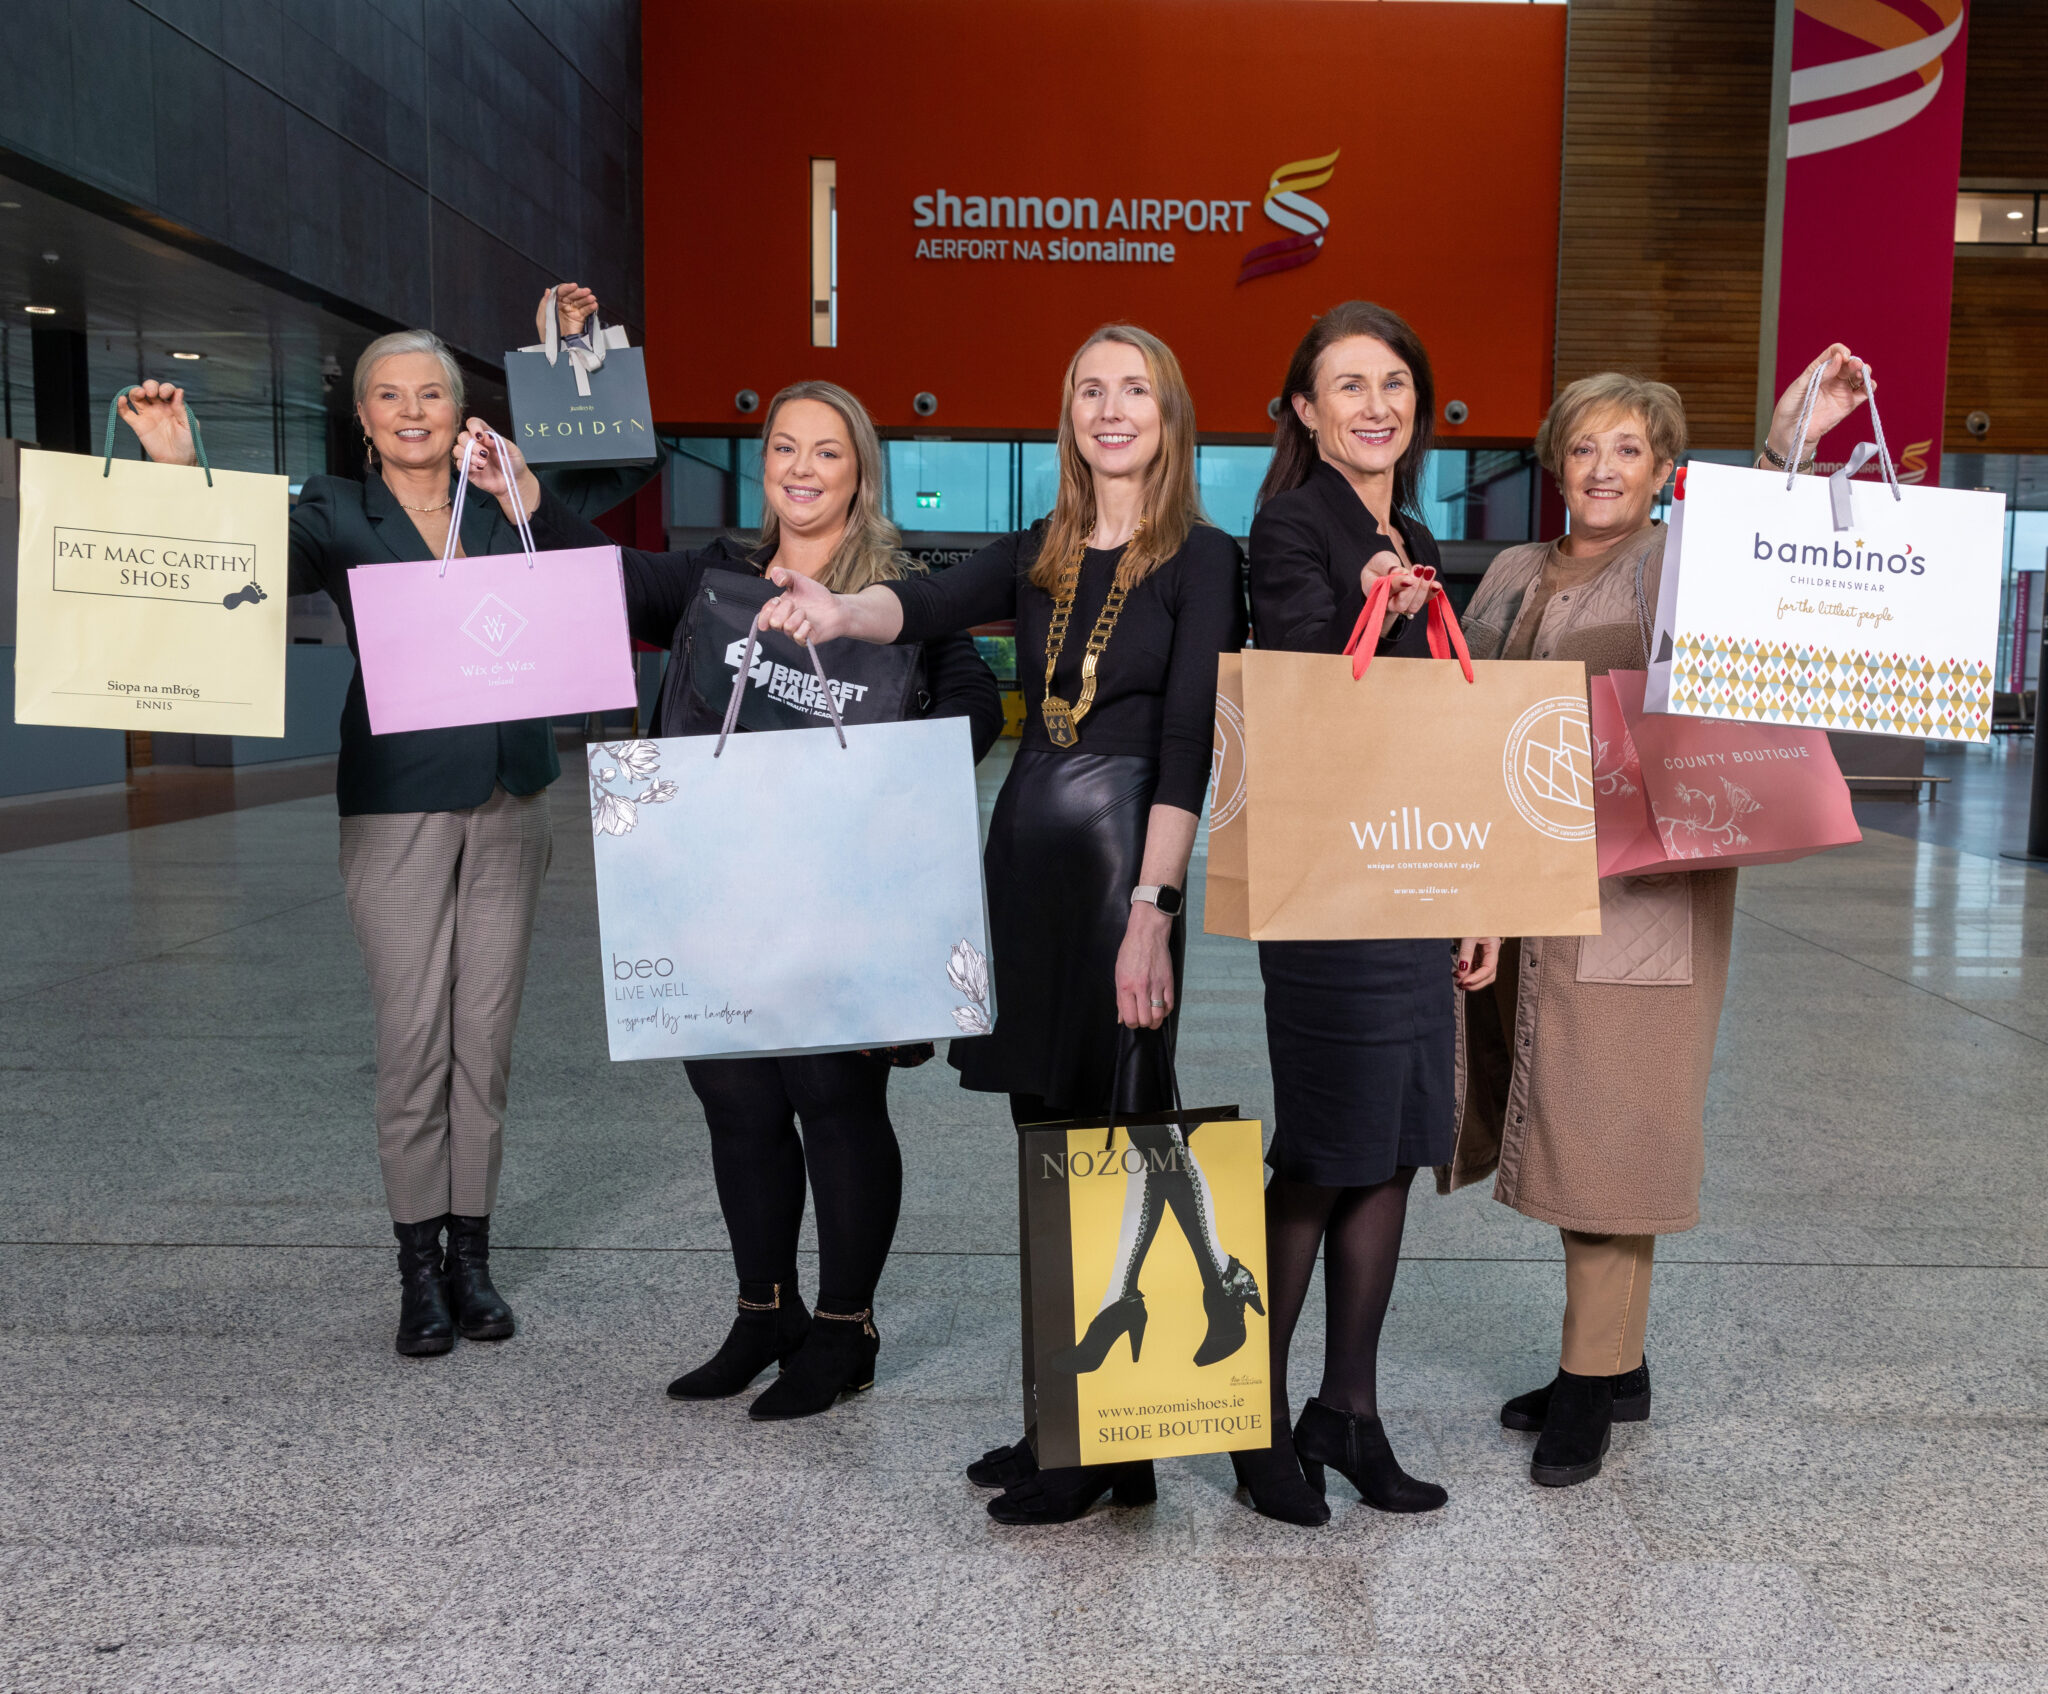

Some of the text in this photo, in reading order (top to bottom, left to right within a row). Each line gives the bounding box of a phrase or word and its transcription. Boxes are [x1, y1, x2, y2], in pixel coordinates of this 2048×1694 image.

[913, 189, 1251, 232] shannon AIRPORT
[915, 236, 1175, 263] AERFORT NA sionainne
[58, 541, 252, 573] PAT MAC CARTHY
[1754, 532, 1926, 576] bambino's
[120, 569, 190, 590] SHOES
[1790, 576, 1885, 592] CHILDRENSWEAR
[1777, 597, 1893, 629] for the littlest people
[460, 660, 536, 676] Wix & Wax
[107, 680, 140, 694] Siopa
[144, 684, 158, 694] na
[768, 678, 846, 714] HAREN
[772, 664, 868, 702] BRIDGET
[136, 700, 172, 710] ENNIS
[1664, 746, 1810, 771] COUNTY BOUTIQUE
[1350, 806, 1492, 850] willow
[1460, 861, 1480, 870] style
[1394, 886, 1458, 894] www.willow.ie
[613, 953, 674, 980] beo
[615, 982, 688, 1000] LIVE WELL
[618, 1007, 658, 1032] inspired
[662, 1006, 680, 1034] by
[704, 1002, 754, 1024] landscape
[1040, 1146, 1191, 1180] NOZOMI
[1098, 1395, 1244, 1418] www.nozomishoes.ie
[1099, 1414, 1262, 1444] SHOE BOUTIQUE
